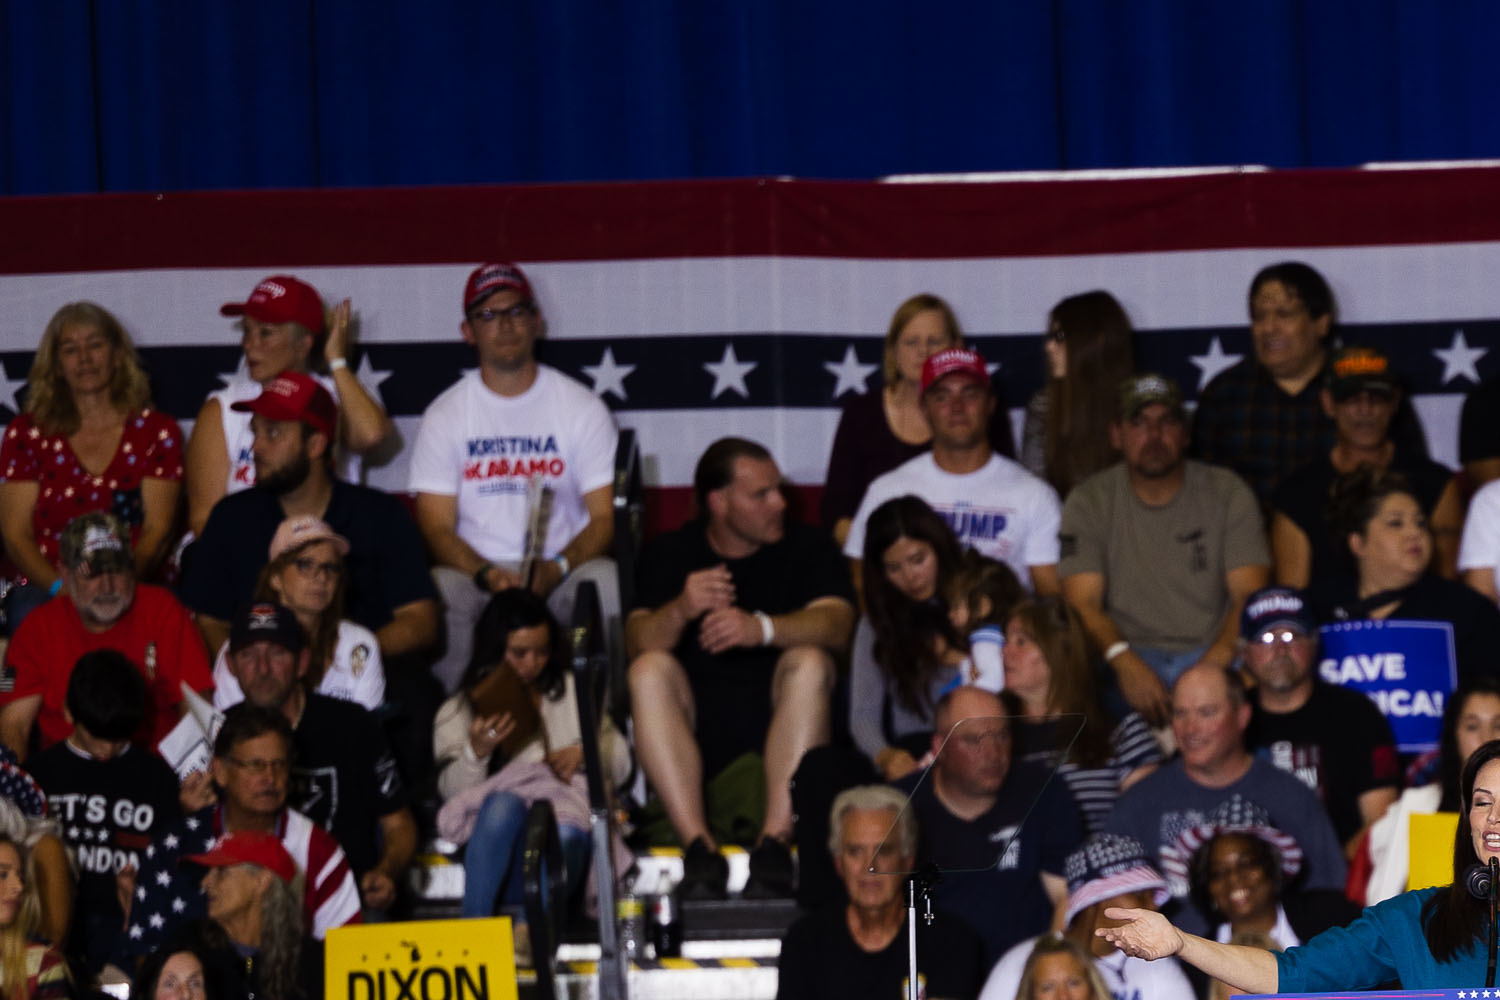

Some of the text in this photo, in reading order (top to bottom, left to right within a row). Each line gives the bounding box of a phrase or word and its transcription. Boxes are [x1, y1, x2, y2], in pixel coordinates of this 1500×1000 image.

[468, 437, 559, 456] KRISTINA
[464, 458, 566, 479] KARAMO
[1319, 653, 1407, 684] SAVE
[113, 798, 154, 831] GO
